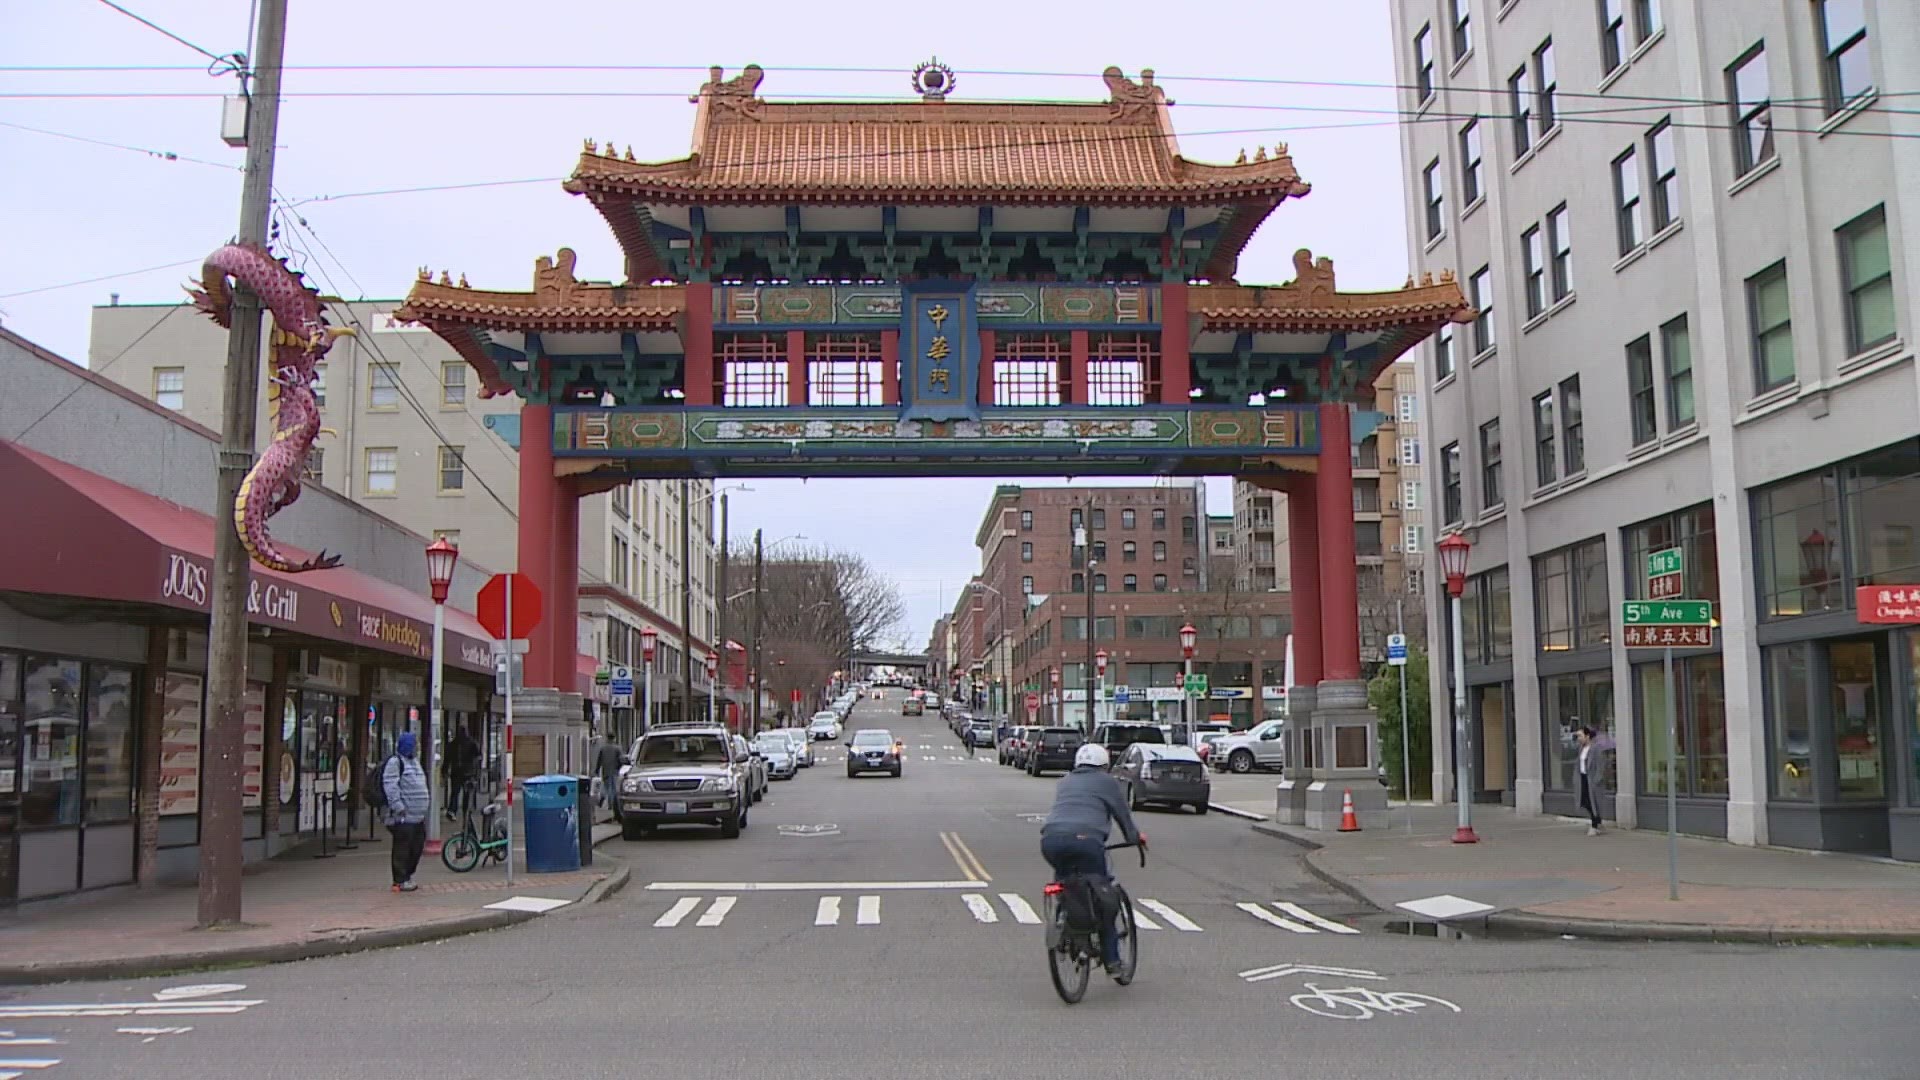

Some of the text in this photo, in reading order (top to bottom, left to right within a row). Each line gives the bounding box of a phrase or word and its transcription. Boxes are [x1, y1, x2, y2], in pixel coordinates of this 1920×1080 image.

[927, 304, 950, 393] 中華門
[247, 580, 260, 613] &
[265, 584, 297, 622] Grill
[1626, 604, 1707, 622] 5th Ave S
[382, 613, 421, 656] hotdog
[1626, 627, 1708, 643] 南第五大道
